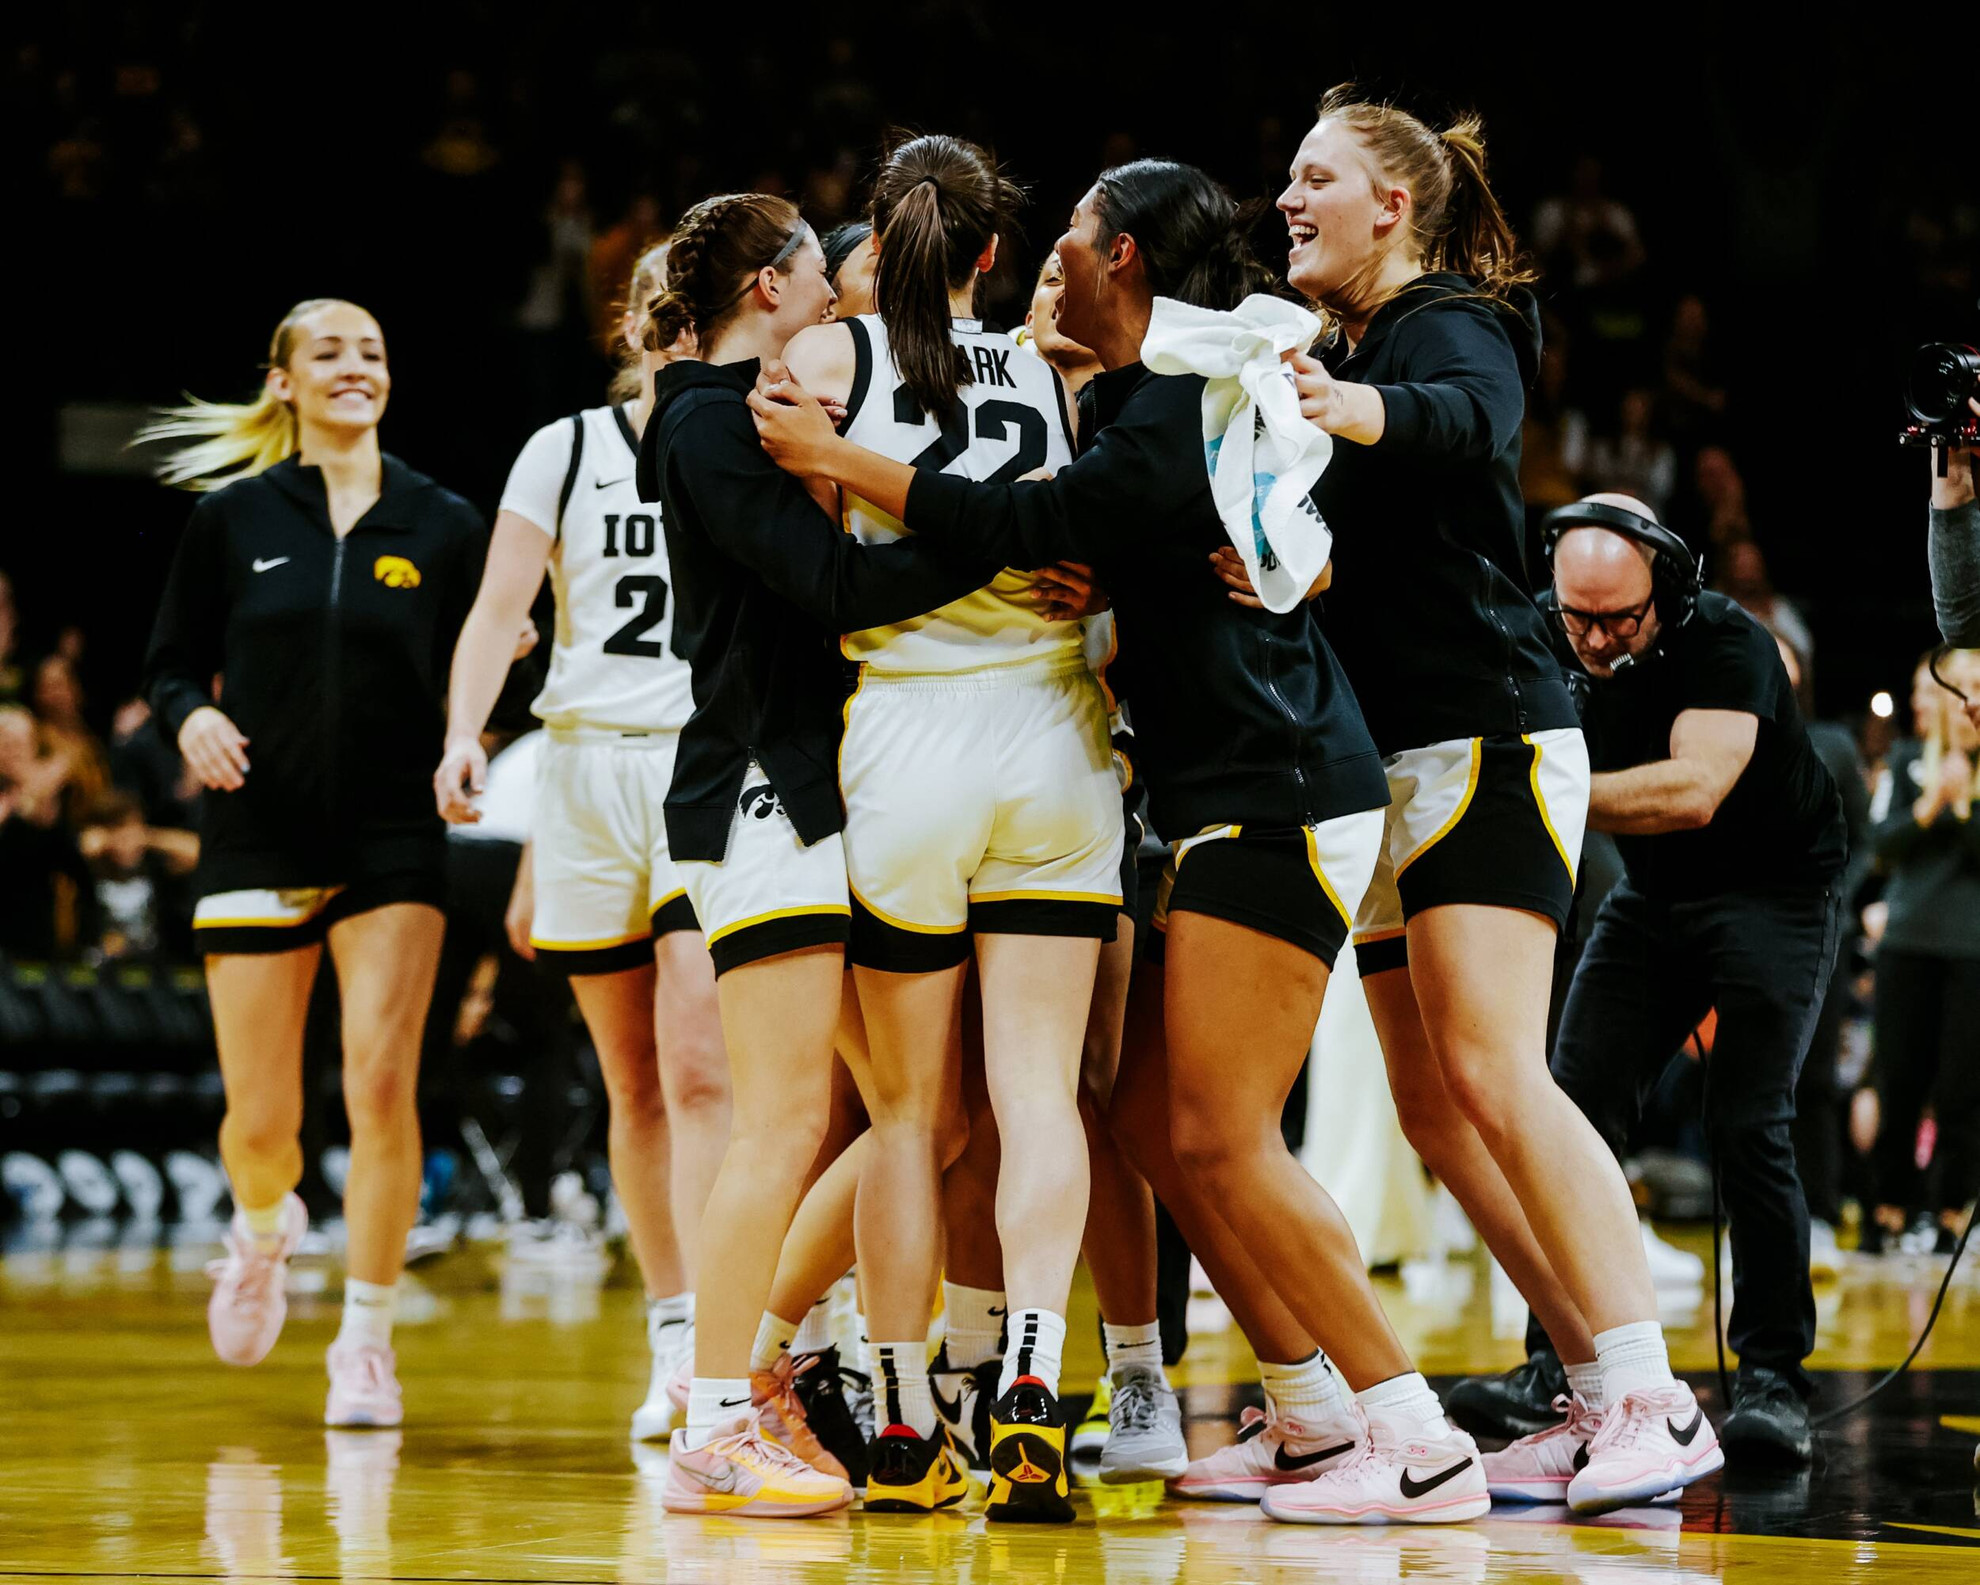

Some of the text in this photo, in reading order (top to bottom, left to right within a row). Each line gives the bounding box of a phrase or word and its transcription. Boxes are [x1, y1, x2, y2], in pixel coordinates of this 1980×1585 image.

[957, 344, 1017, 389] ARK
[893, 380, 1048, 484] 22
[603, 514, 664, 558] IO
[603, 575, 690, 659] 2
